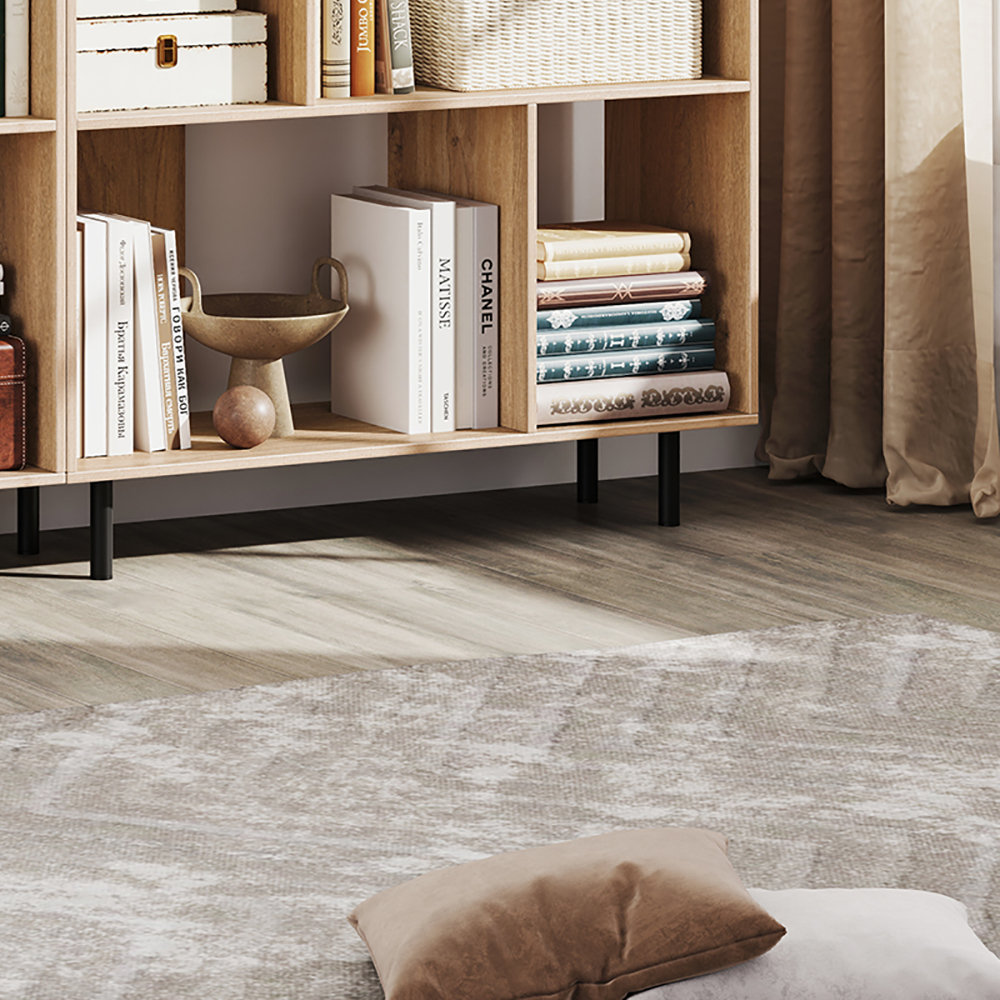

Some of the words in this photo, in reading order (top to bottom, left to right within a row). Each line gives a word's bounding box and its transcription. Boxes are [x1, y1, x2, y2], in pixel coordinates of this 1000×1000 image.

[356, 8, 371, 53] JUMBO
[390, 2, 410, 50] SHACK
[438, 257, 451, 329] MATISSE
[481, 258, 492, 334] CHANEL
[114, 320, 128, 363] Братья
[172, 306, 184, 363] ГОВОРИ
[114, 366, 128, 439] Карамазовы
[177, 368, 186, 390] КАК
[179, 394, 188, 416] БОГ
